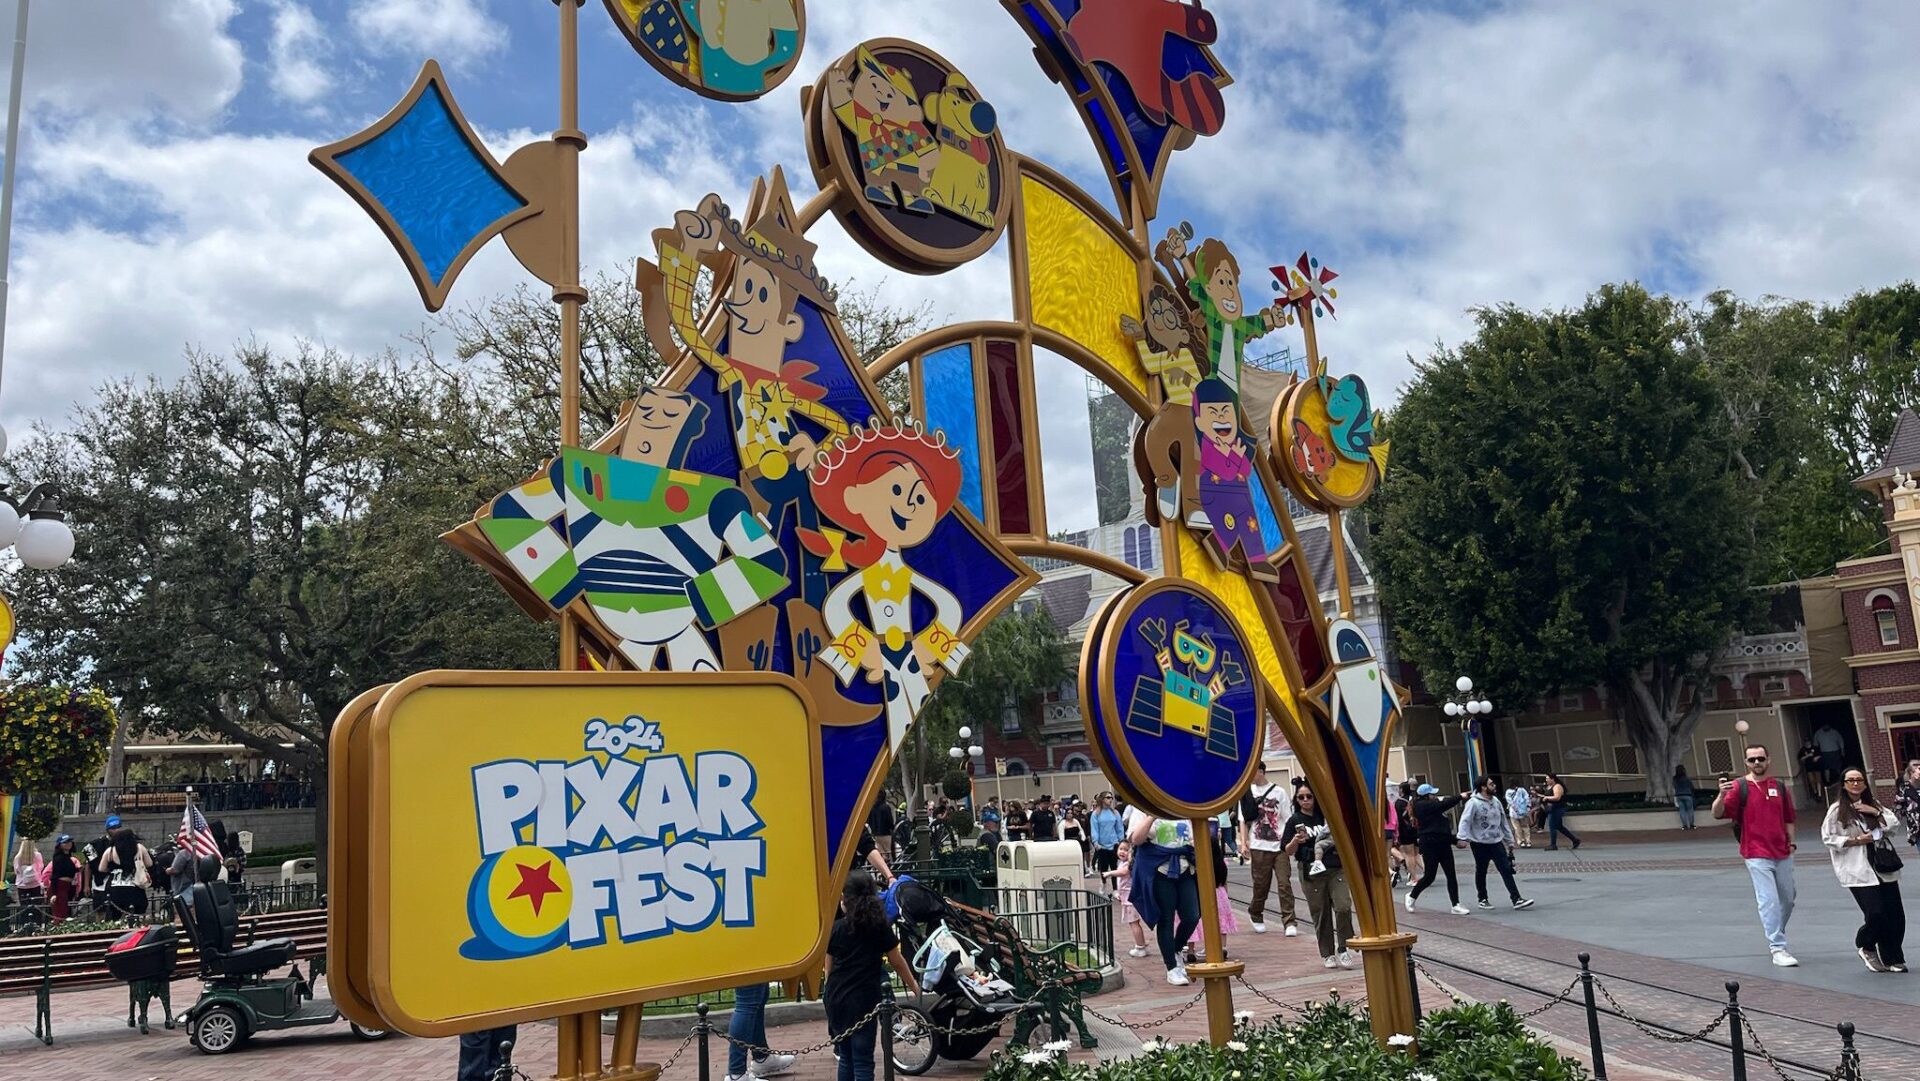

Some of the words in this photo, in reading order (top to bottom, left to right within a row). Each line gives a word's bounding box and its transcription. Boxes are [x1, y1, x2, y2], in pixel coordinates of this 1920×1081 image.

[584, 716, 664, 756] 2024
[472, 752, 765, 857] PIXAR
[565, 838, 765, 948] FEST
